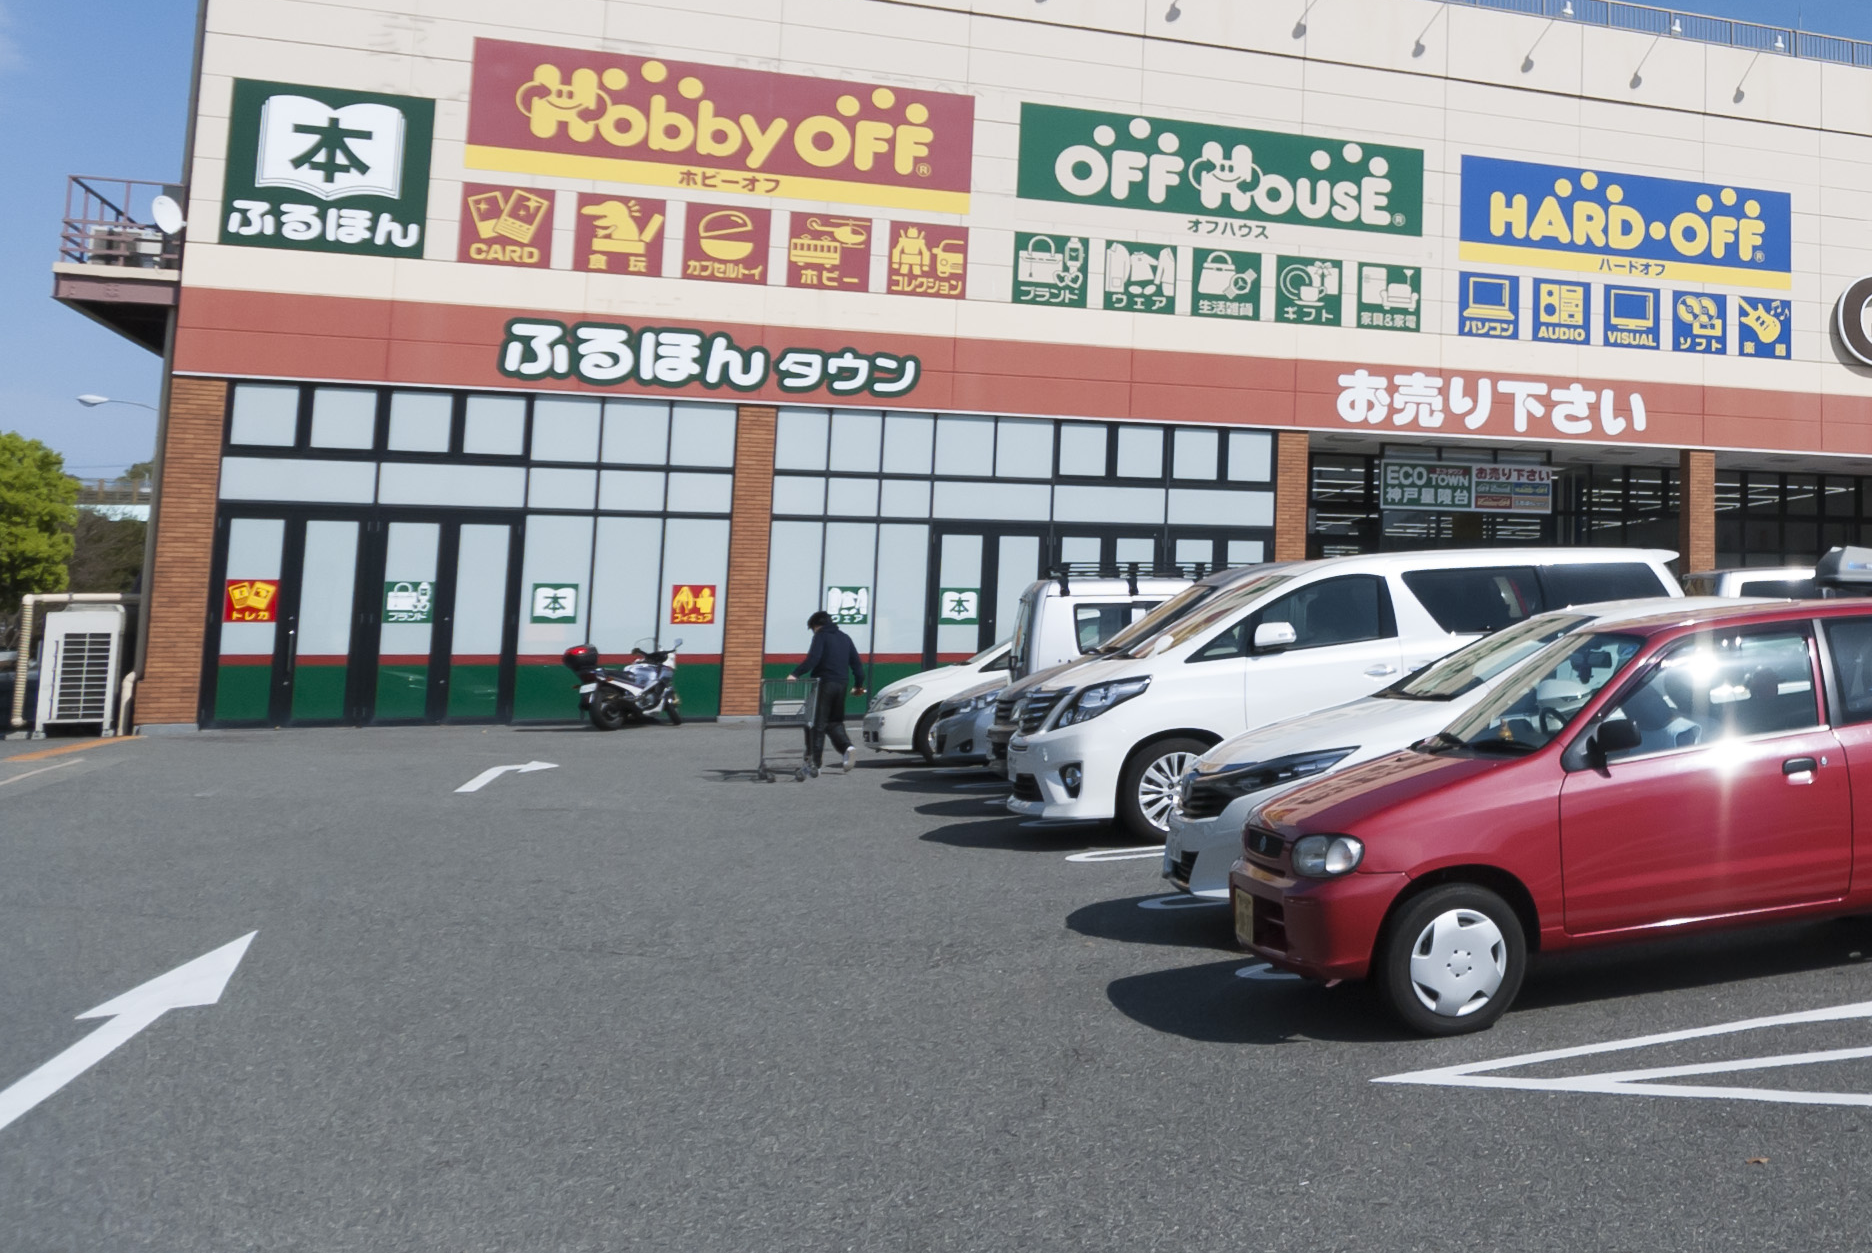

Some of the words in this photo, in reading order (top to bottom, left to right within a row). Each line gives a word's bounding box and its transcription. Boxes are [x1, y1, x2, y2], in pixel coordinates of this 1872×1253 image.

[289, 117, 374, 184] 本
[794, 113, 936, 175] OFF
[679, 170, 781, 193] ホビーオフ
[1055, 144, 1185, 204] OFF
[228, 200, 420, 248] ふるほん
[1187, 218, 1270, 240] オフハウス
[469, 242, 541, 264] CARD
[686, 260, 764, 281] カプセルトイ
[1599, 258, 1667, 276] ハードオフ
[800, 269, 860, 287] ホビー
[891, 275, 963, 295] コレクション
[1020, 286, 1080, 304] ブランド
[1111, 293, 1168, 311] ウェア
[1198, 299, 1254, 318] 生活雑貨
[1283, 306, 1334, 323] ギフト
[1464, 320, 1514, 337] パソコン
[1538, 327, 1586, 342] AUDIO
[1608, 330, 1657, 347] VISUAL
[1679, 336, 1722, 352] ソフト
[1336, 369, 1647, 436] お売り下さい
[1386, 465, 1427, 485] ECO
[1430, 474, 1469, 487] TOWN
[1475, 466, 1551, 482] お売り下さい
[543, 593, 567, 614] 本
[949, 597, 971, 616] 本
[231, 610, 270, 621] トレカ
[388, 612, 427, 622] ブランド
